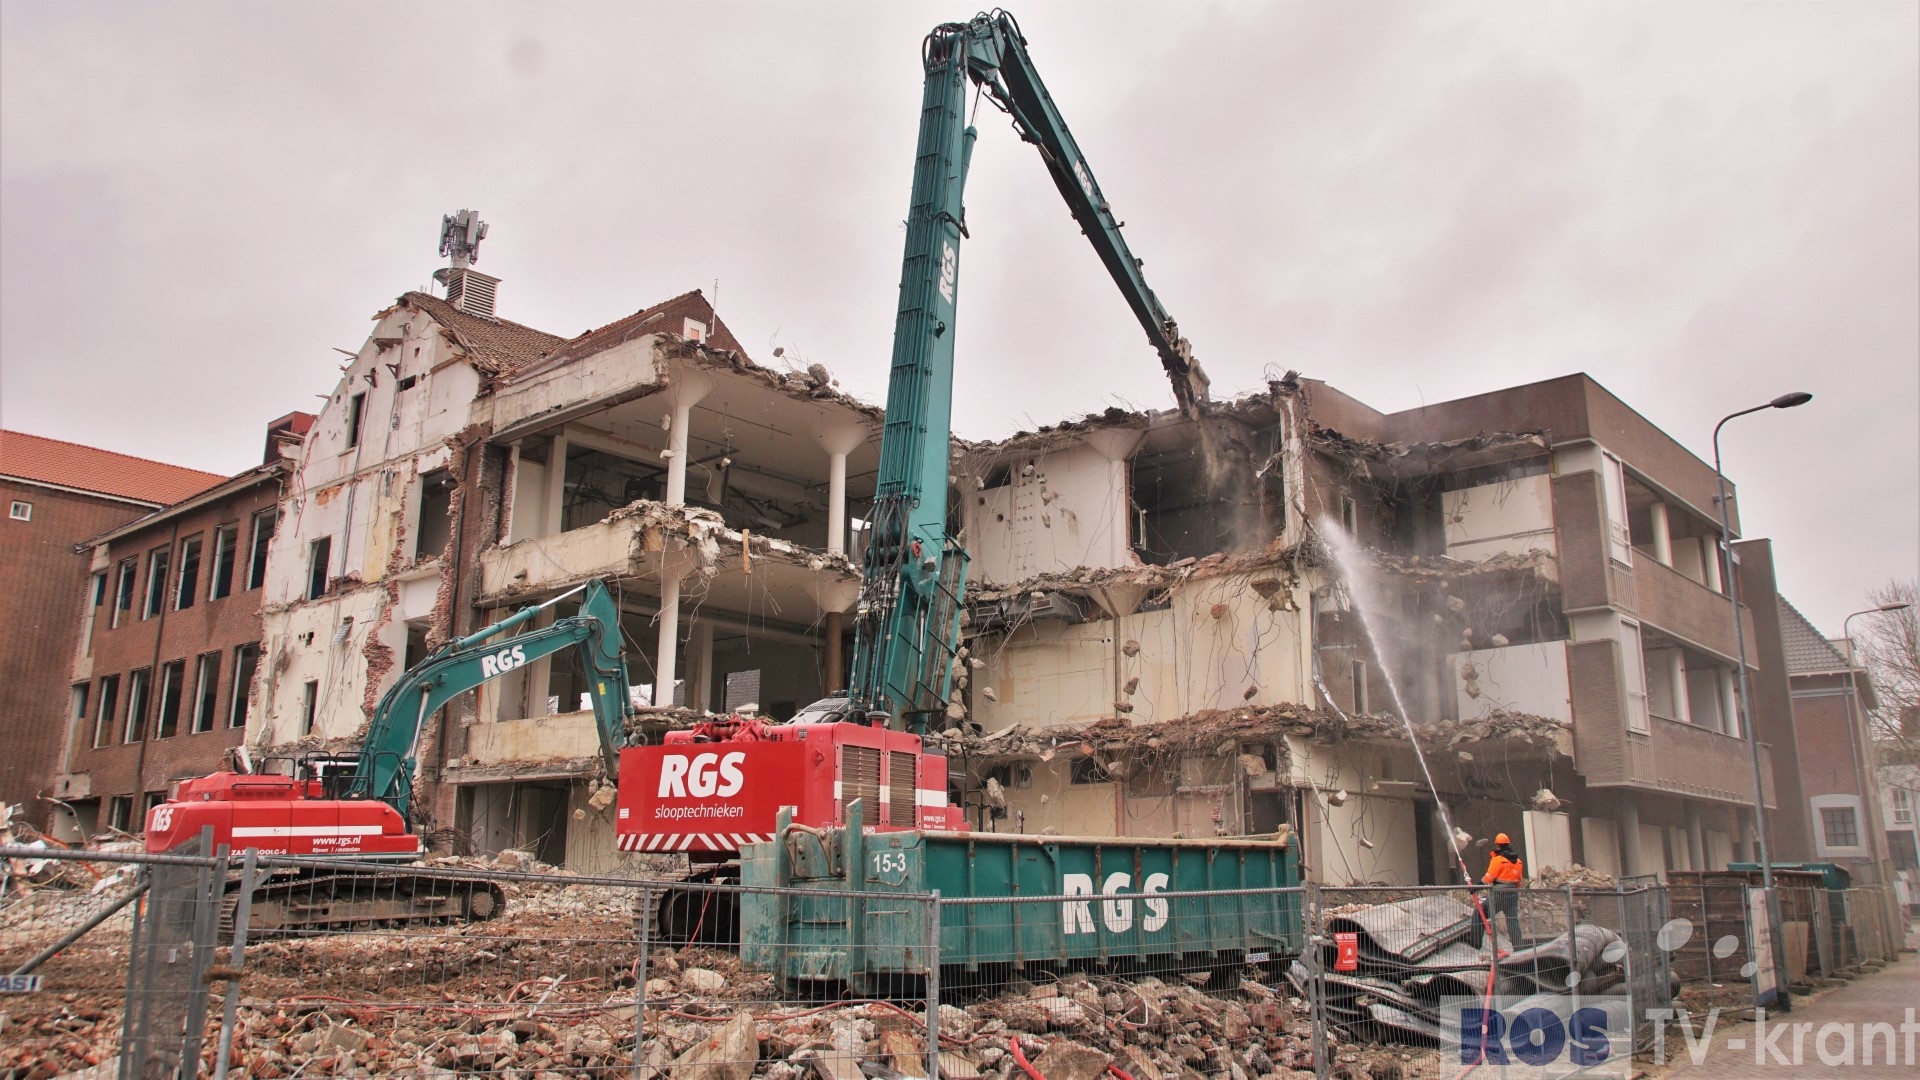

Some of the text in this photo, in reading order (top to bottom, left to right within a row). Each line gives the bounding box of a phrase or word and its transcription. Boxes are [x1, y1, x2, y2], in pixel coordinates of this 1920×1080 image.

[1074, 159, 1093, 197] RGS
[939, 240, 956, 306] RGS
[481, 644, 526, 679] RGS
[657, 751, 746, 798] RGS
[150, 808, 175, 832] RGS
[655, 803, 744, 821] slooptechnieken
[312, 835, 362, 847] www.rgs.nl
[873, 852, 906, 873] 15-3
[1062, 871, 1170, 935] RGS
